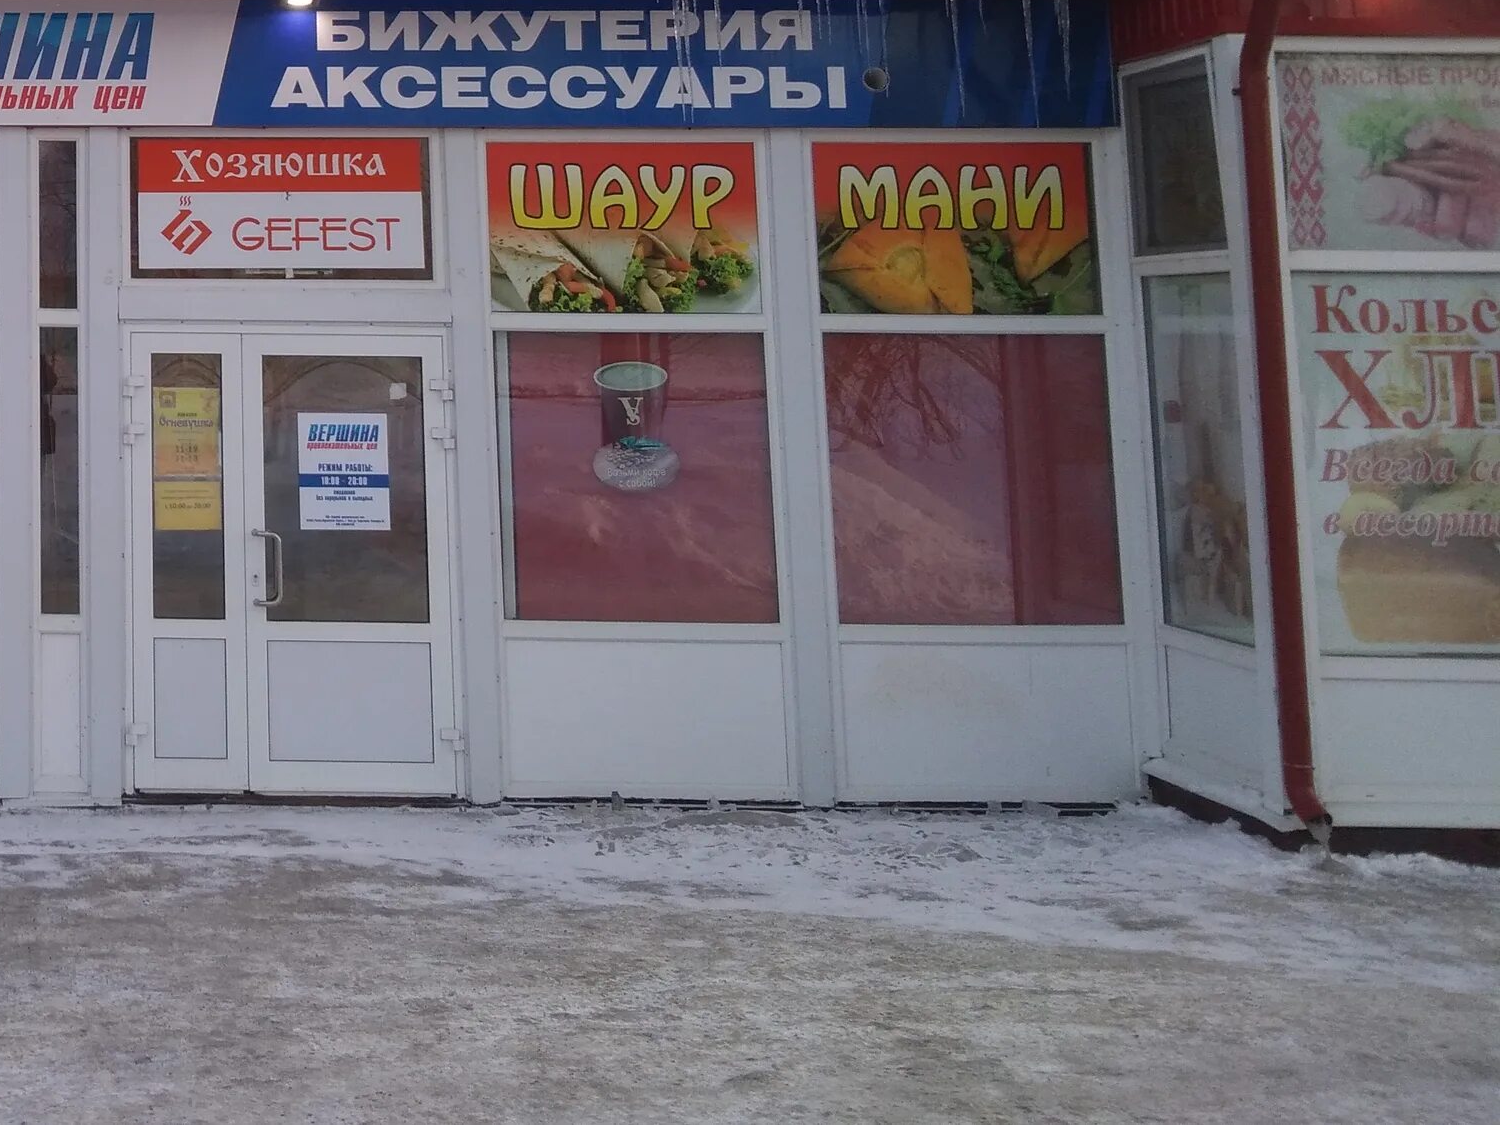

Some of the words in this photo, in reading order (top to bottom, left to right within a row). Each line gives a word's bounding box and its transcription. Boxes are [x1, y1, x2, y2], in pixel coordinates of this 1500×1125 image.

[315, 9, 814, 52] БИЖУТЕРИЯ
[93, 84, 146, 115] цен
[270, 65, 847, 110] АКСЕССУАРЫ
[172, 149, 386, 183] Хозяюшка
[509, 163, 735, 230] ШАУР
[837, 164, 1064, 230] МАНИ
[231, 217, 400, 252] GEFEST
[1308, 284, 1500, 334] Кольс
[1314, 350, 1500, 430] ХЛ
[308, 424, 379, 442] ВЕРШИНА
[318, 463, 342, 472] РЕЖИМ
[1318, 448, 1457, 483] Всегда
